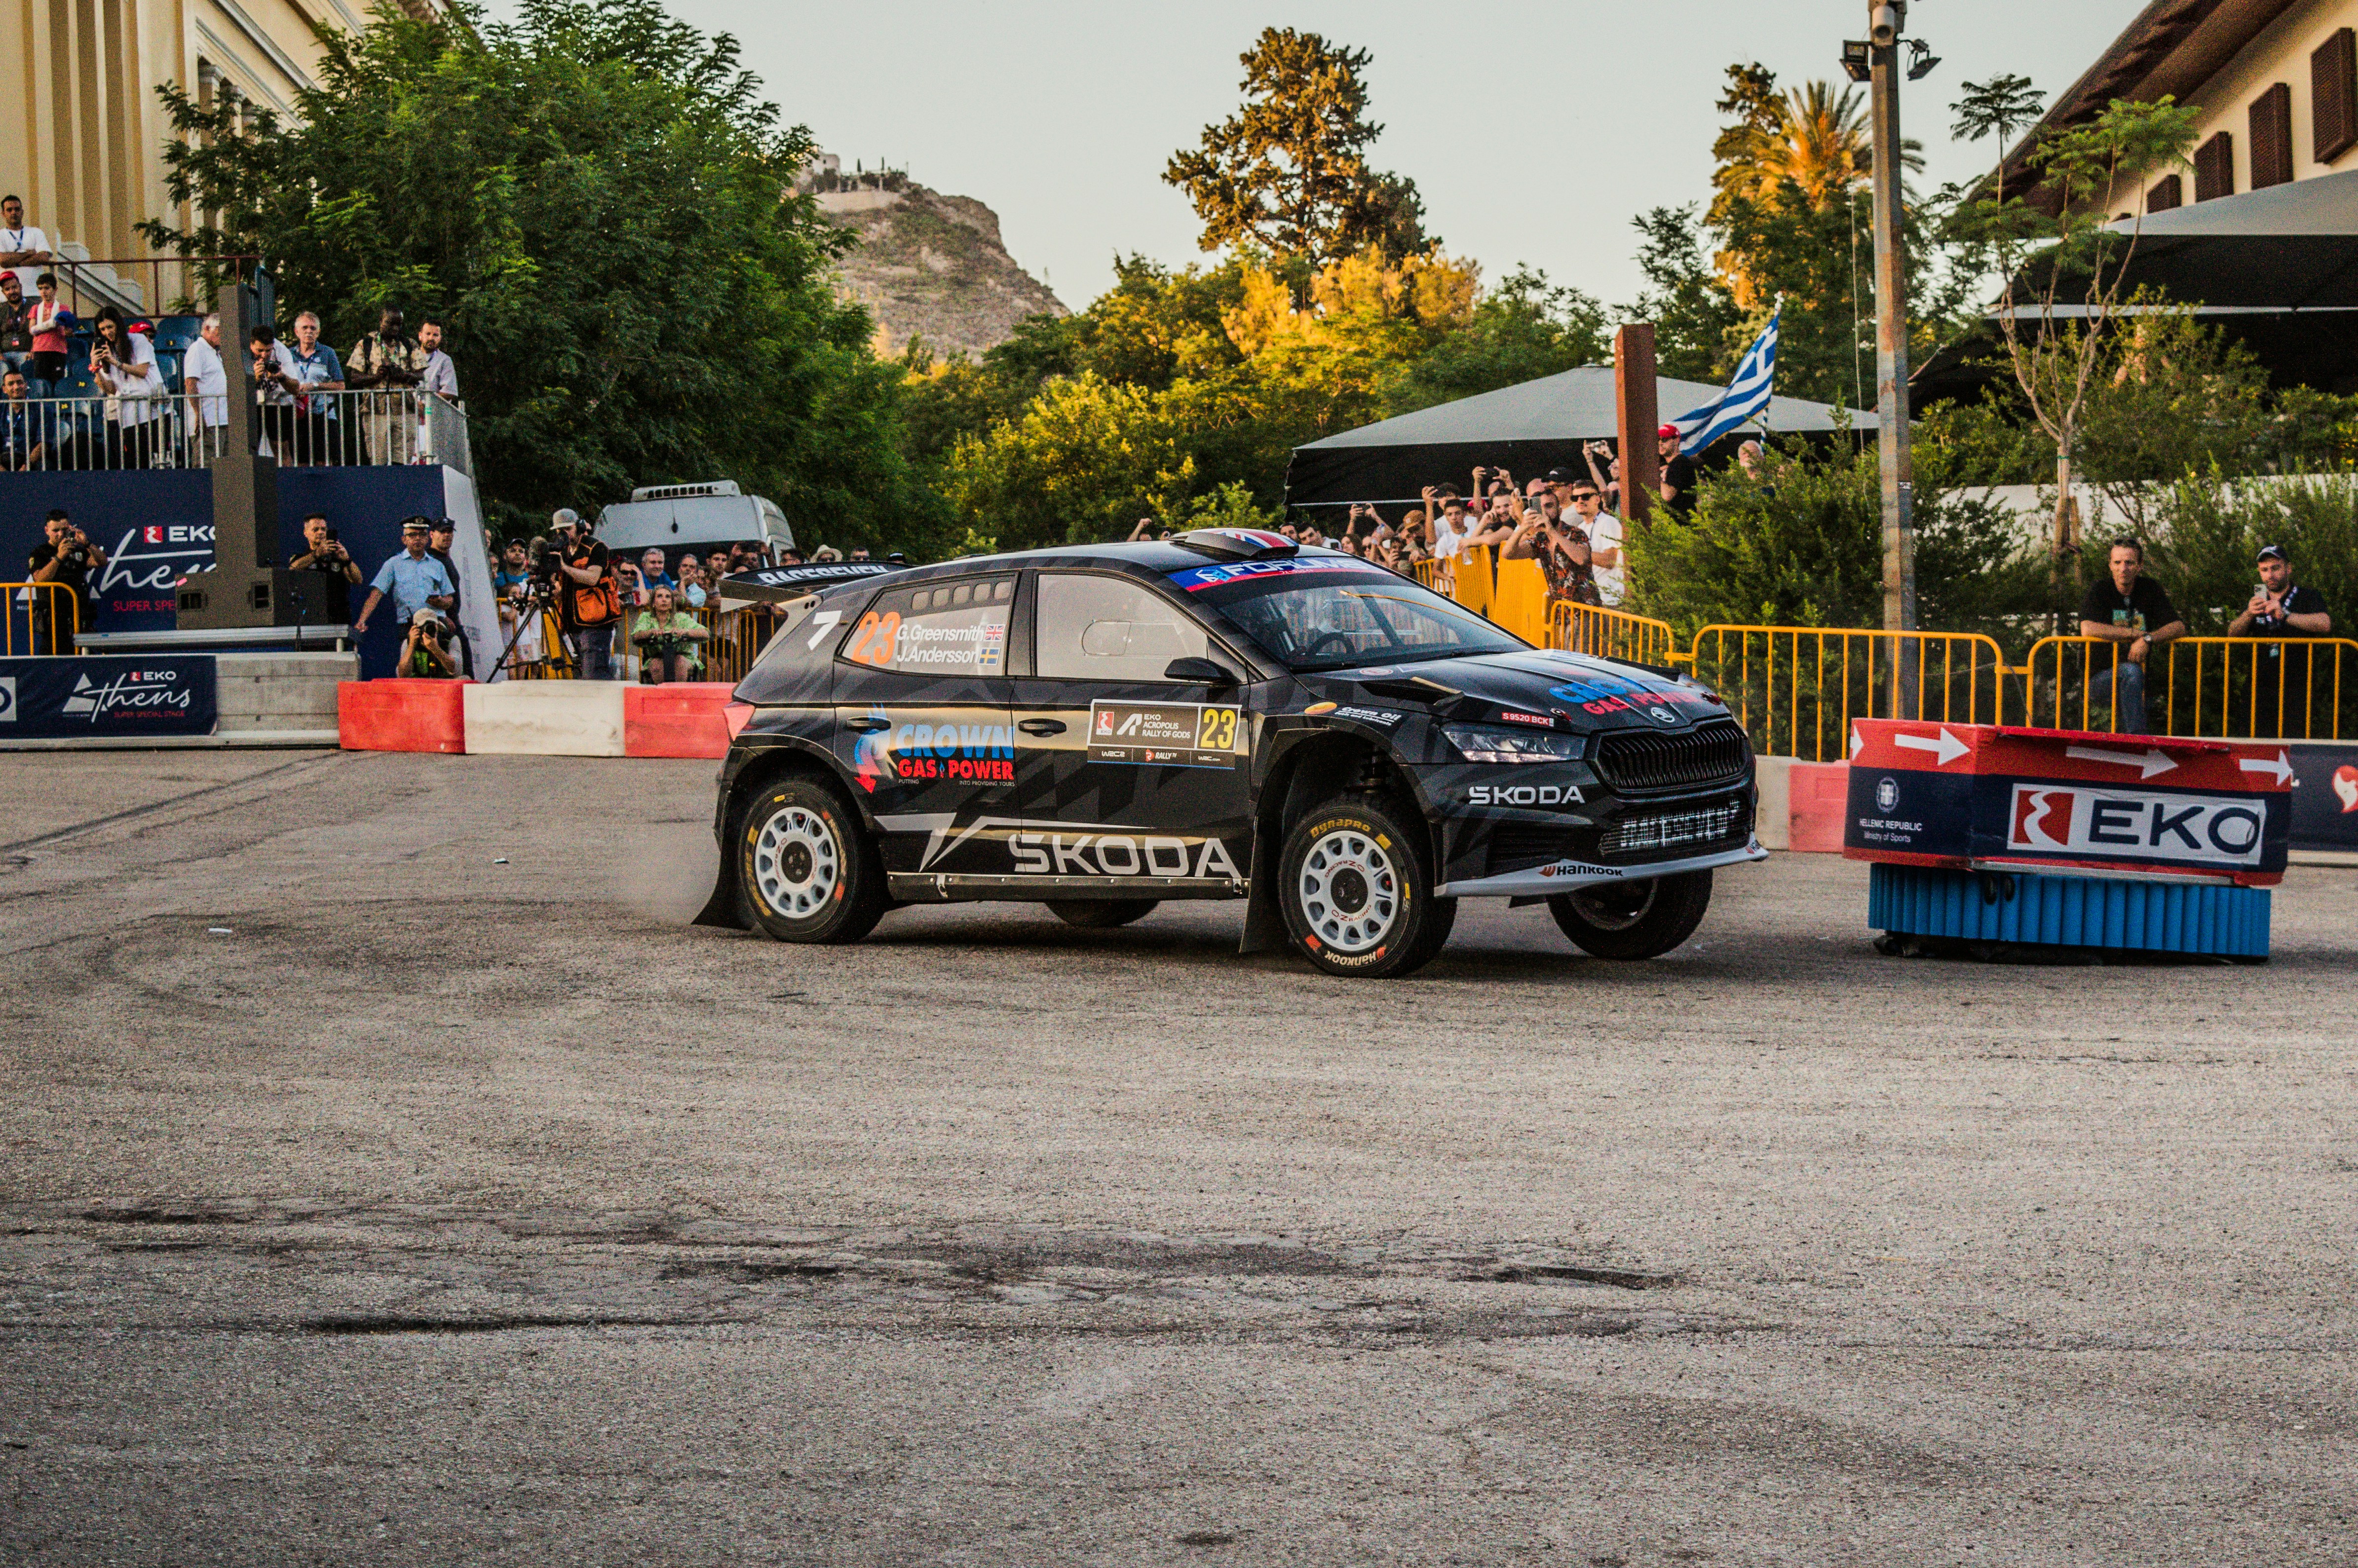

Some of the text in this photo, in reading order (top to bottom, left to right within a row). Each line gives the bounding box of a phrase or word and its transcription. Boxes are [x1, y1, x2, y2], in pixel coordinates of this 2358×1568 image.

[168, 526, 216, 542] EK
[113, 600, 176, 612] SUPER SPE
[807, 611, 842, 650] 7
[851, 611, 901, 665] 23
[897, 624, 984, 641] G.Greensmith
[897, 646, 979, 663] J.Andersson
[143, 671, 177, 681] EKO
[1549, 677, 1651, 703] CRO
[1342, 706, 1402, 721] Crown Oil
[1582, 696, 1630, 715] GAS
[1142, 721, 1179, 730] ACROPOLIS
[1510, 714, 1530, 723] 9520
[1531, 716, 1549, 725] BCK
[1200, 708, 1236, 749] 23
[896, 724, 1016, 759] CROWN
[898, 758, 1015, 780] GAS POWER
[1885, 820, 1923, 831] REPUBLIC
[2088, 799, 2261, 855] EKO
[1557, 864, 1623, 877] Hankook
